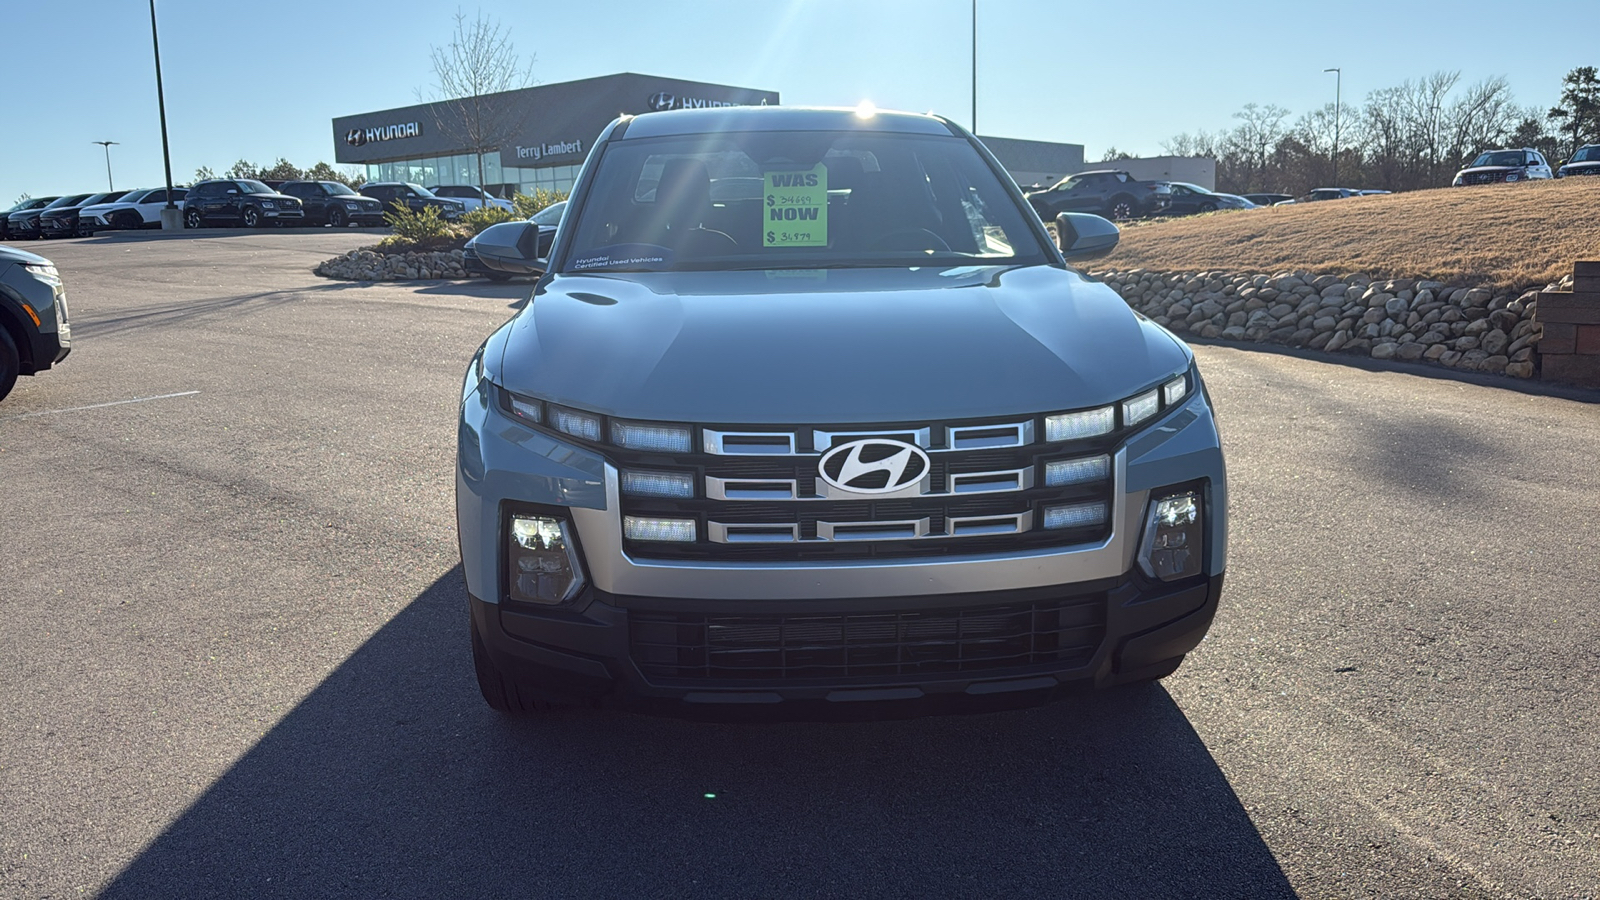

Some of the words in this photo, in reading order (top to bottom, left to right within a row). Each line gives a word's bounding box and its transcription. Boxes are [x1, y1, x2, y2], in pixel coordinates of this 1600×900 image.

[365, 122, 419, 143] HYUNDAI
[516, 145, 541, 160] Terry
[541, 139, 582, 156] Lambert
[771, 173, 818, 188] WAS
[766, 194, 776, 207] $
[770, 207, 819, 221] NOW
[766, 230, 776, 243] $
[574, 261, 608, 269] Certified
[630, 256, 663, 264] Vehicles
[575, 256, 609, 264] Hyundai
